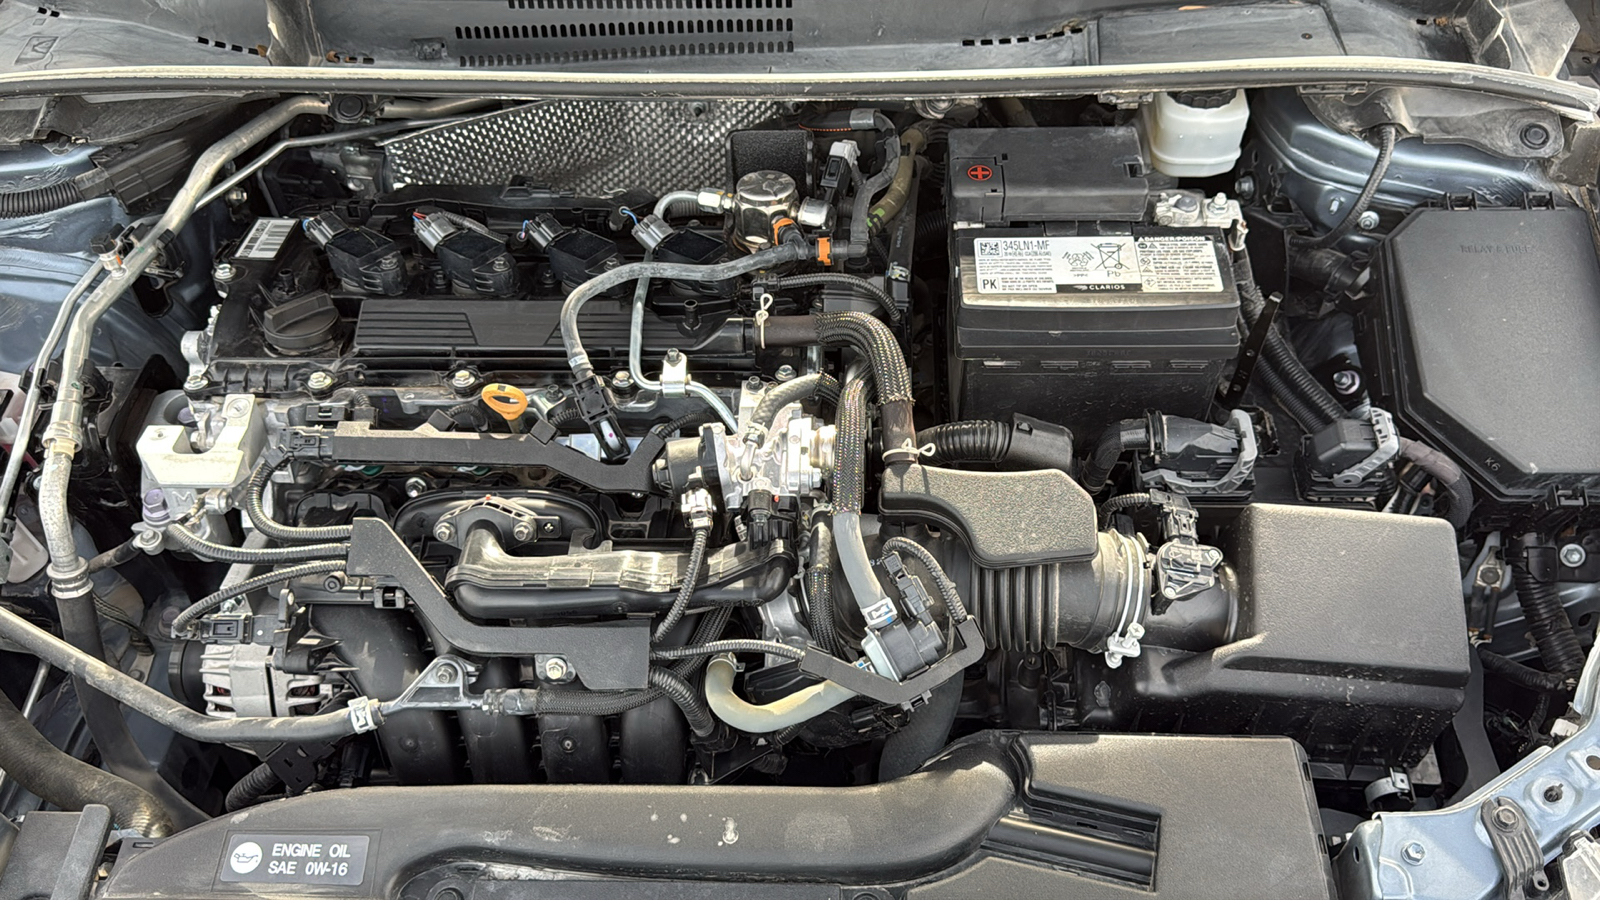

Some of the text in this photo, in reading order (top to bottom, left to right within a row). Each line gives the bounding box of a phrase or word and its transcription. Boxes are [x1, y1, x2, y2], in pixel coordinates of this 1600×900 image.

[1003, 240, 1050, 250] 345LN1-MF
[1460, 245, 1493, 253] RELAY
[982, 279, 997, 290] PK
[1484, 457, 1501, 471] K6
[271, 843, 351, 858] ENGINE OIL
[268, 861, 348, 876] SAE 0W-16
